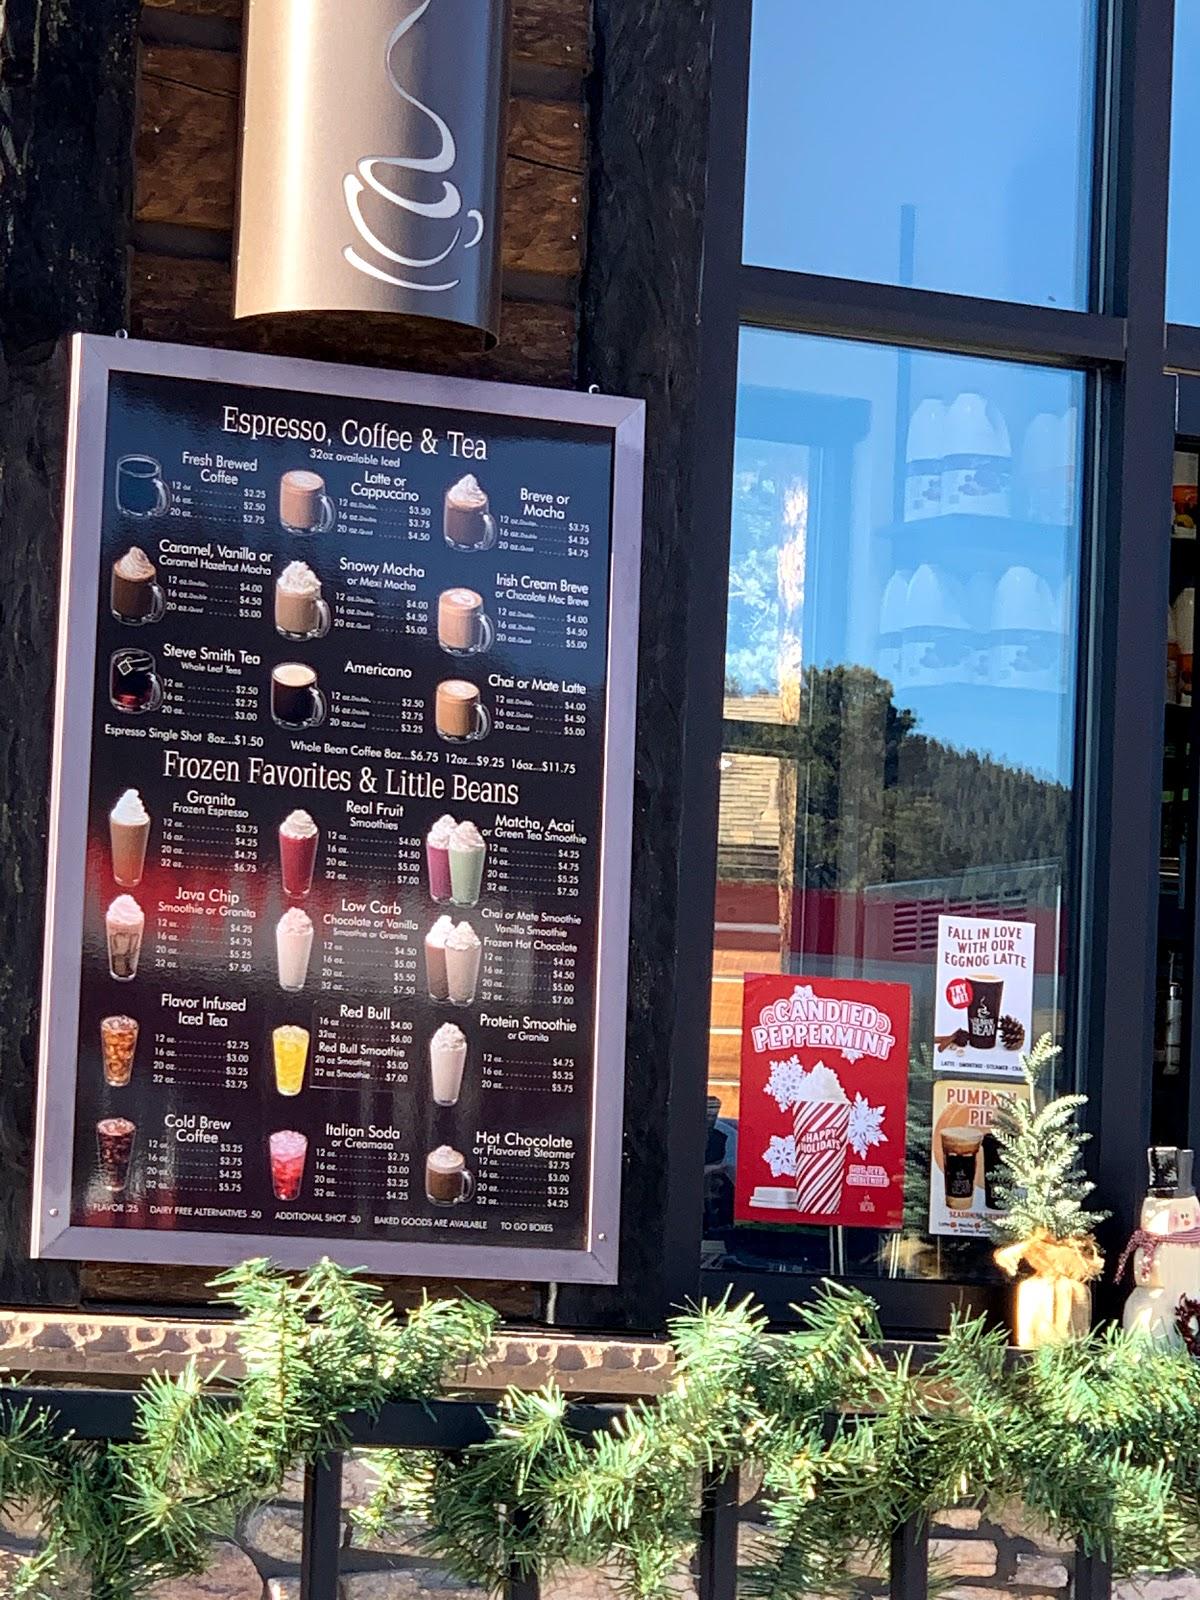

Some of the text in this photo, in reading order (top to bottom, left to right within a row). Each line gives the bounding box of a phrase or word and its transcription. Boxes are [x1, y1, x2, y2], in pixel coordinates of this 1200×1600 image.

[221, 405, 487, 460] Espresso, Coffee & Tea
[182, 451, 258, 472] Fresh Brewed
[309, 447, 401, 468] 32oz available Iced
[200, 468, 239, 485] Coffee
[364, 470, 407, 487] Latte or
[350, 482, 419, 502] Cappuccino
[520, 487, 570, 505] Breve or
[243, 501, 266, 512] $2.50
[408, 505, 431, 516] $3.50
[523, 503, 565, 520] Mocha
[159, 538, 273, 562] Caramel, Vanilla or
[567, 547, 589, 558] $4.75
[158, 554, 272, 576] Caramel Hazelnut Mocha
[339, 556, 425, 578] Snowy Mocha
[346, 576, 417, 592] or Mexi Mocha
[496, 572, 589, 595] Irish Cream Breve
[495, 589, 589, 607] or Chocolate Mac Breve
[565, 639, 588, 650] $5.00
[163, 643, 261, 665] Steve Smith Tea
[180, 661, 206, 672] Whole
[344, 660, 412, 679] Americano
[488, 673, 587, 695] Chai or Mate Latte
[104, 723, 202, 742] Espresso Single Shot
[290, 740, 382, 758] Whole Bean Coffee
[163, 750, 519, 805] Frozen Favorites & Little Beans
[186, 789, 236, 807] Granita
[172, 801, 249, 818] Frozen Espresso
[346, 799, 404, 817] Real Fruit
[349, 816, 399, 831] Smoothies
[495, 814, 575, 833] Matcha, Acai
[481, 826, 587, 845] or Green Tea Smoothie
[175, 886, 240, 907] Java Chip
[557, 886, 579, 897] $7.50
[158, 901, 256, 918] Smoothie or Granita
[341, 898, 402, 916] Low Carb
[323, 913, 419, 931] Chocolate or Vanilla
[481, 907, 582, 925] Chai or Mate Smoothie
[494, 923, 568, 938] Vanilla Smoothie
[947, 926, 1022, 940] FALL IN LOVE
[483, 936, 578, 953] Frozen Hot Chocolate
[957, 940, 1014, 953] WITH OUR
[944, 952, 1027, 968] EGGNOG LATTE
[161, 993, 247, 1012] Flavor Infused
[178, 1011, 228, 1027] Iced Tea
[340, 1004, 391, 1020] Red Bull
[773, 999, 878, 1027] CANDIED
[480, 1013, 577, 1032] Protein Smoothie
[507, 1031, 549, 1042] or Granita
[752, 1024, 894, 1060] PEPPERMINT
[318, 1041, 406, 1058] Red Bull Smoothie
[225, 1079, 248, 1090] $3.75
[164, 1113, 231, 1130] Cold Brew
[970, 1110, 993, 1126] PIE
[175, 1128, 219, 1144] Coffee
[325, 1123, 400, 1140] Italian Soda
[476, 1131, 573, 1149] Hot Chocolate
[805, 1127, 837, 1143] HAPPY
[331, 1137, 394, 1150] or Creamosa
[472, 1144, 576, 1160] or Flavored Steamer
[92, 1202, 124, 1213] FLAVOR
[149, 1205, 173, 1215] DAIRY
[174, 1206, 193, 1216] FREE
[193, 1207, 248, 1218] ALTERNATIVES
[547, 1198, 569, 1209] $4.25
[274, 1211, 324, 1222] ADDITIONAL
[324, 1213, 347, 1223] SHOT
[374, 1215, 487, 1230] BAKED GOODS ARE AVAILABLE
[500, 1221, 554, 1233] TO GO BOXES
